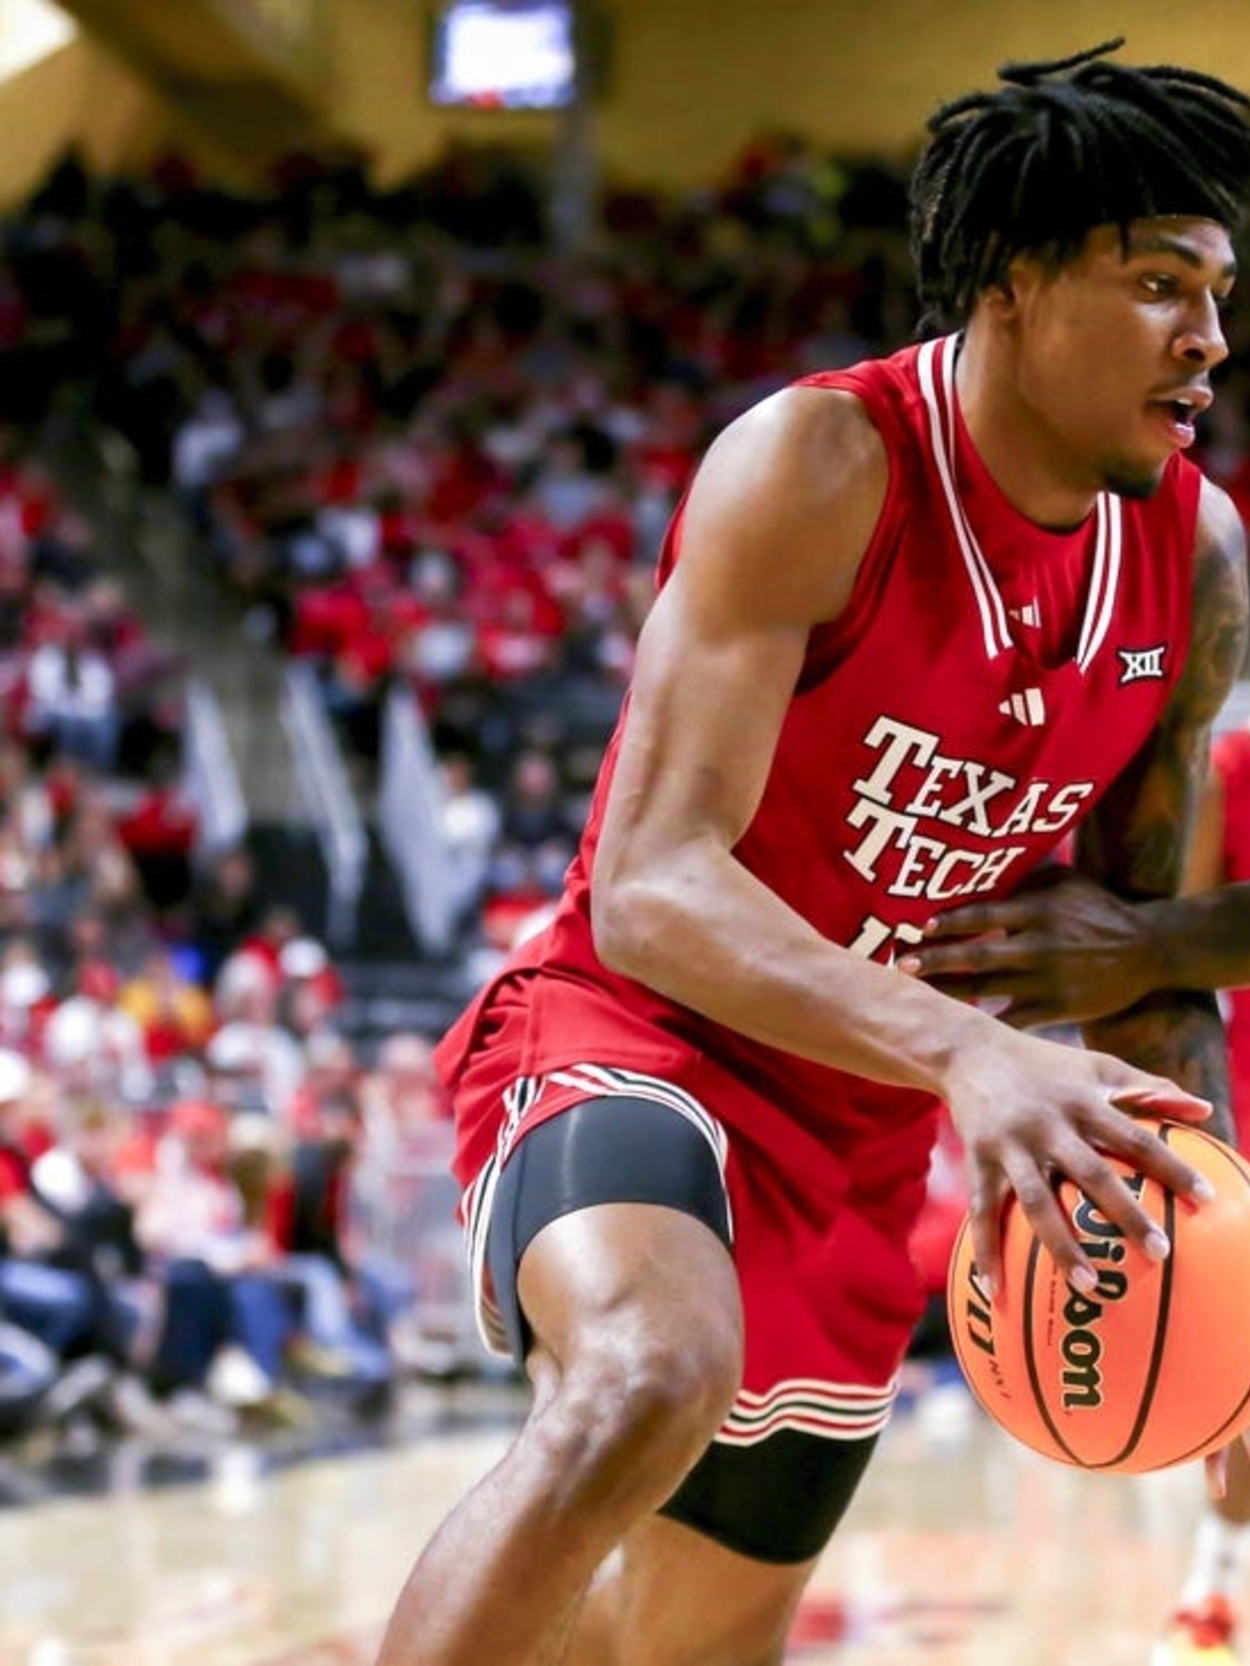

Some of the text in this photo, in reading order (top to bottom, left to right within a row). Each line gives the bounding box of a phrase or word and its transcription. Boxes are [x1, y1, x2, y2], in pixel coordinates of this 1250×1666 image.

[1118, 646, 1165, 683] XII
[852, 715, 1094, 837] TEXAS
[843, 798, 1026, 899] TECH
